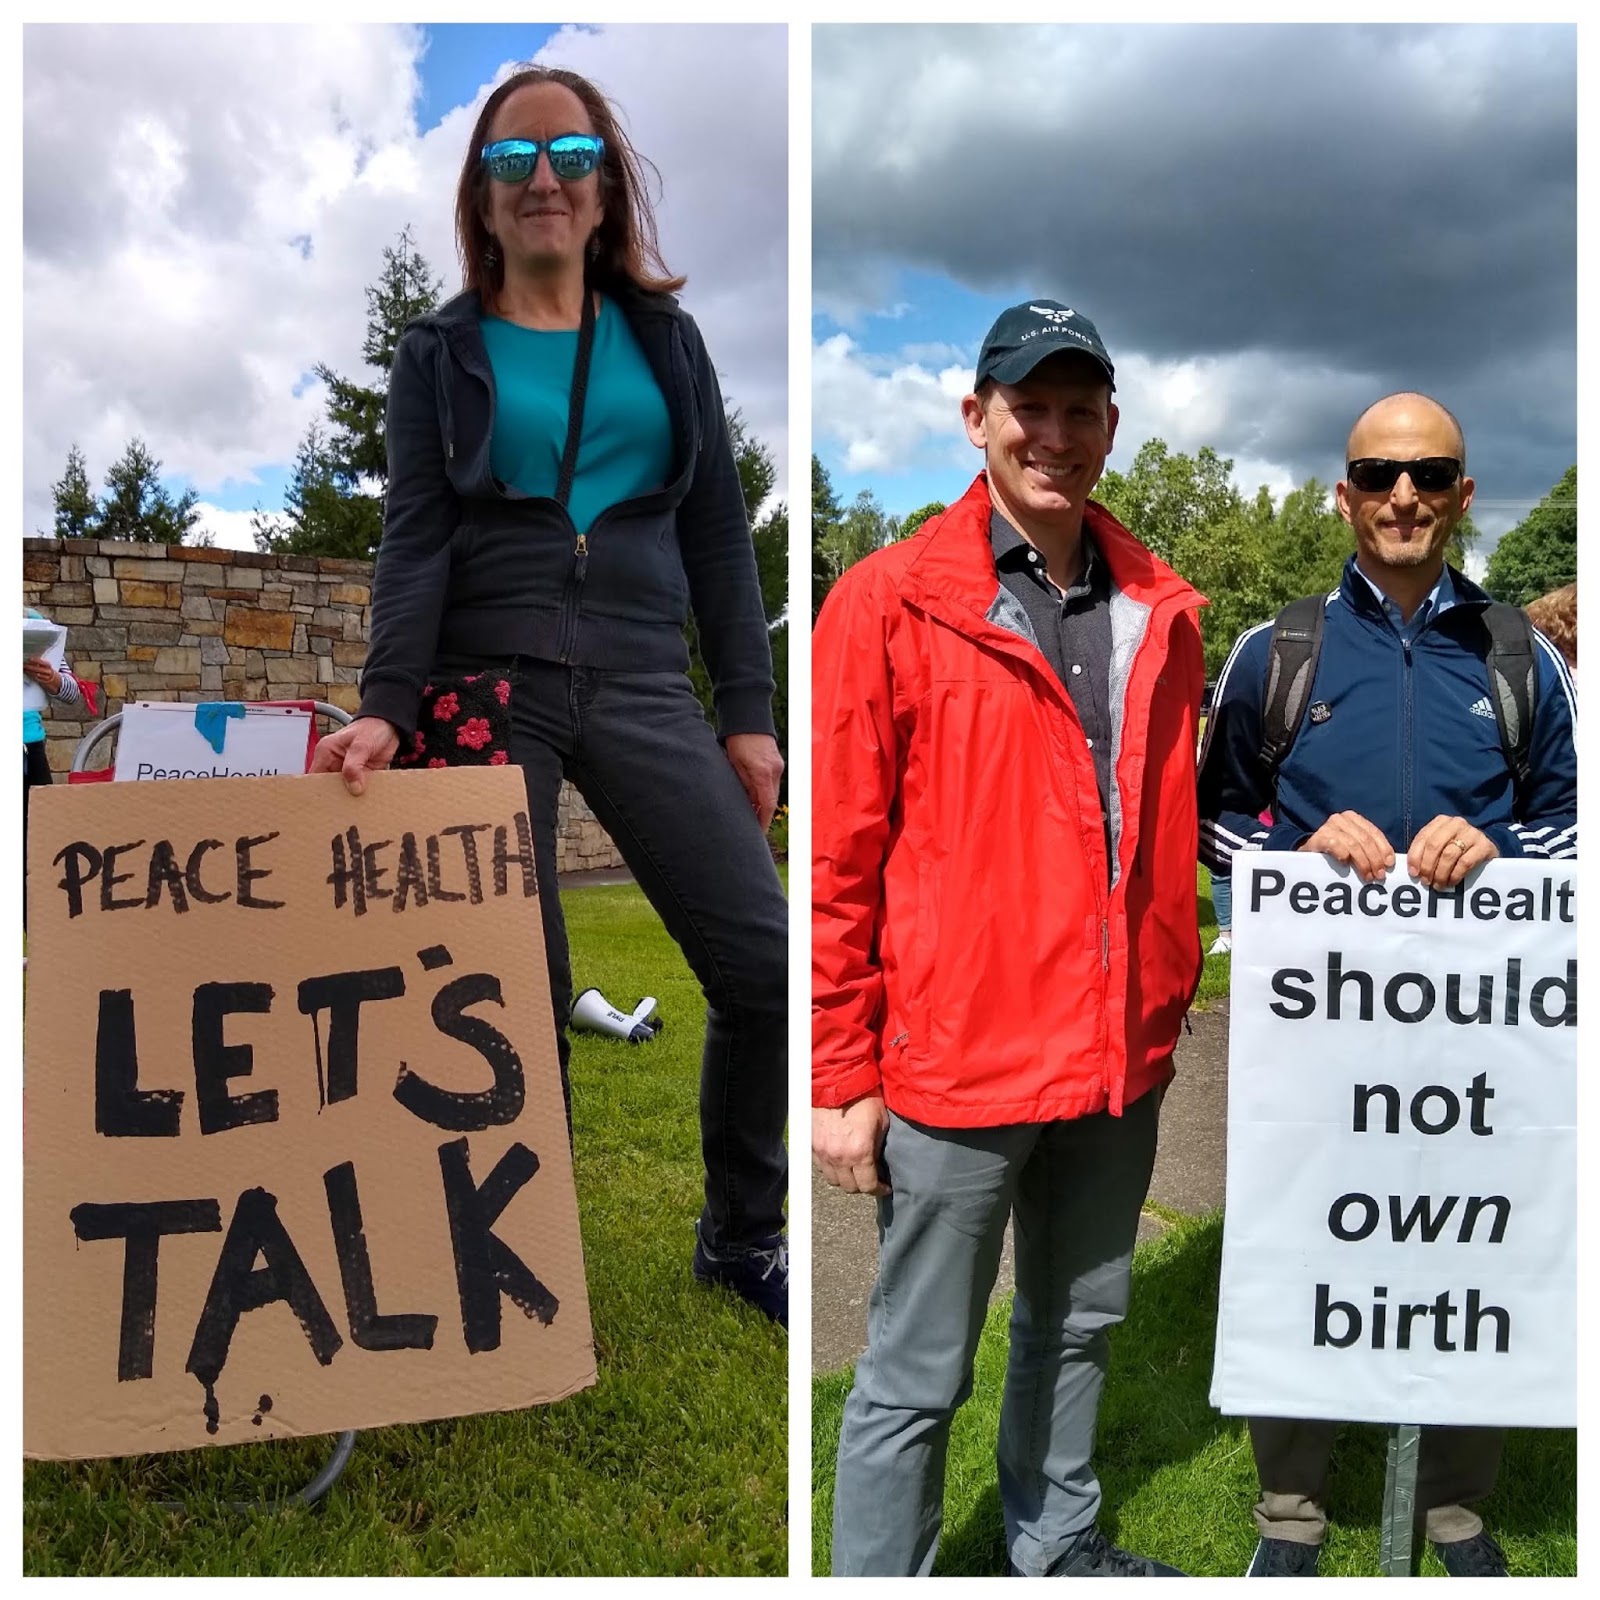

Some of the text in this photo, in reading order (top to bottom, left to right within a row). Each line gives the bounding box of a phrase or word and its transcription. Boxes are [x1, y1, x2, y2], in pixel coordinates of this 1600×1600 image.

[1021, 330, 1039, 341] U.S.
[1041, 326, 1059, 335] AIR
[1468, 706, 1497, 720] adidas
[52, 811, 538, 919] PEACE HEALTH
[1269, 951, 1577, 1028] should
[95, 943, 526, 1137] LET'S
[1353, 1071, 1495, 1136] not
[1328, 1192, 1511, 1244] own
[70, 1136, 560, 1386] TALK
[1313, 1283, 1511, 1353] birth
